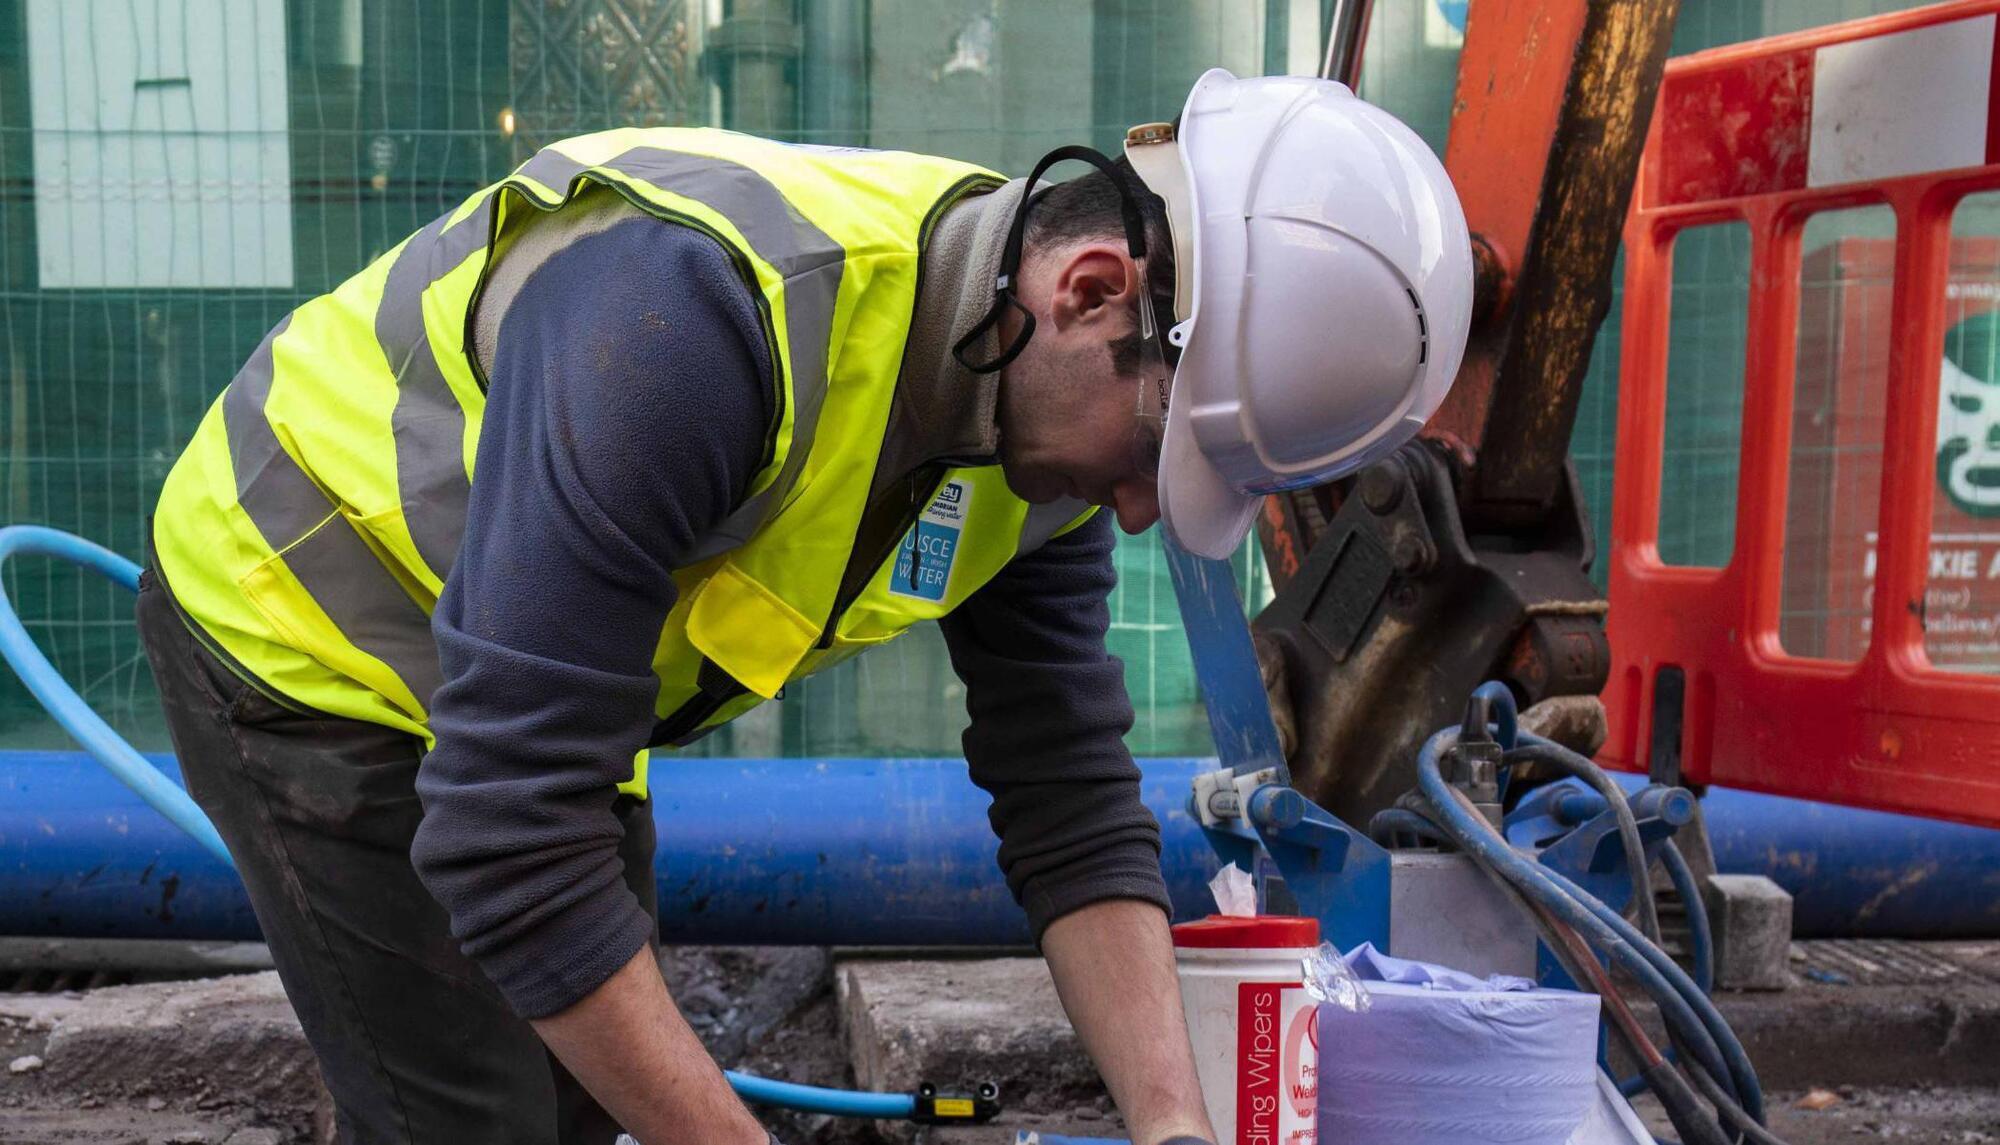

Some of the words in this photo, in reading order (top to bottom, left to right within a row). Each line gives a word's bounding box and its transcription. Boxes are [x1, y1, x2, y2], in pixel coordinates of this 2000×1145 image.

[905, 531, 952, 558] UISCE
[898, 562, 945, 586] WTER
[1248, 992, 1276, 1088] Wipers
[1293, 1084, 1318, 1100] Weld
[1247, 1095, 1276, 1145] ding
[1293, 1127, 1317, 1140] IMPRE
